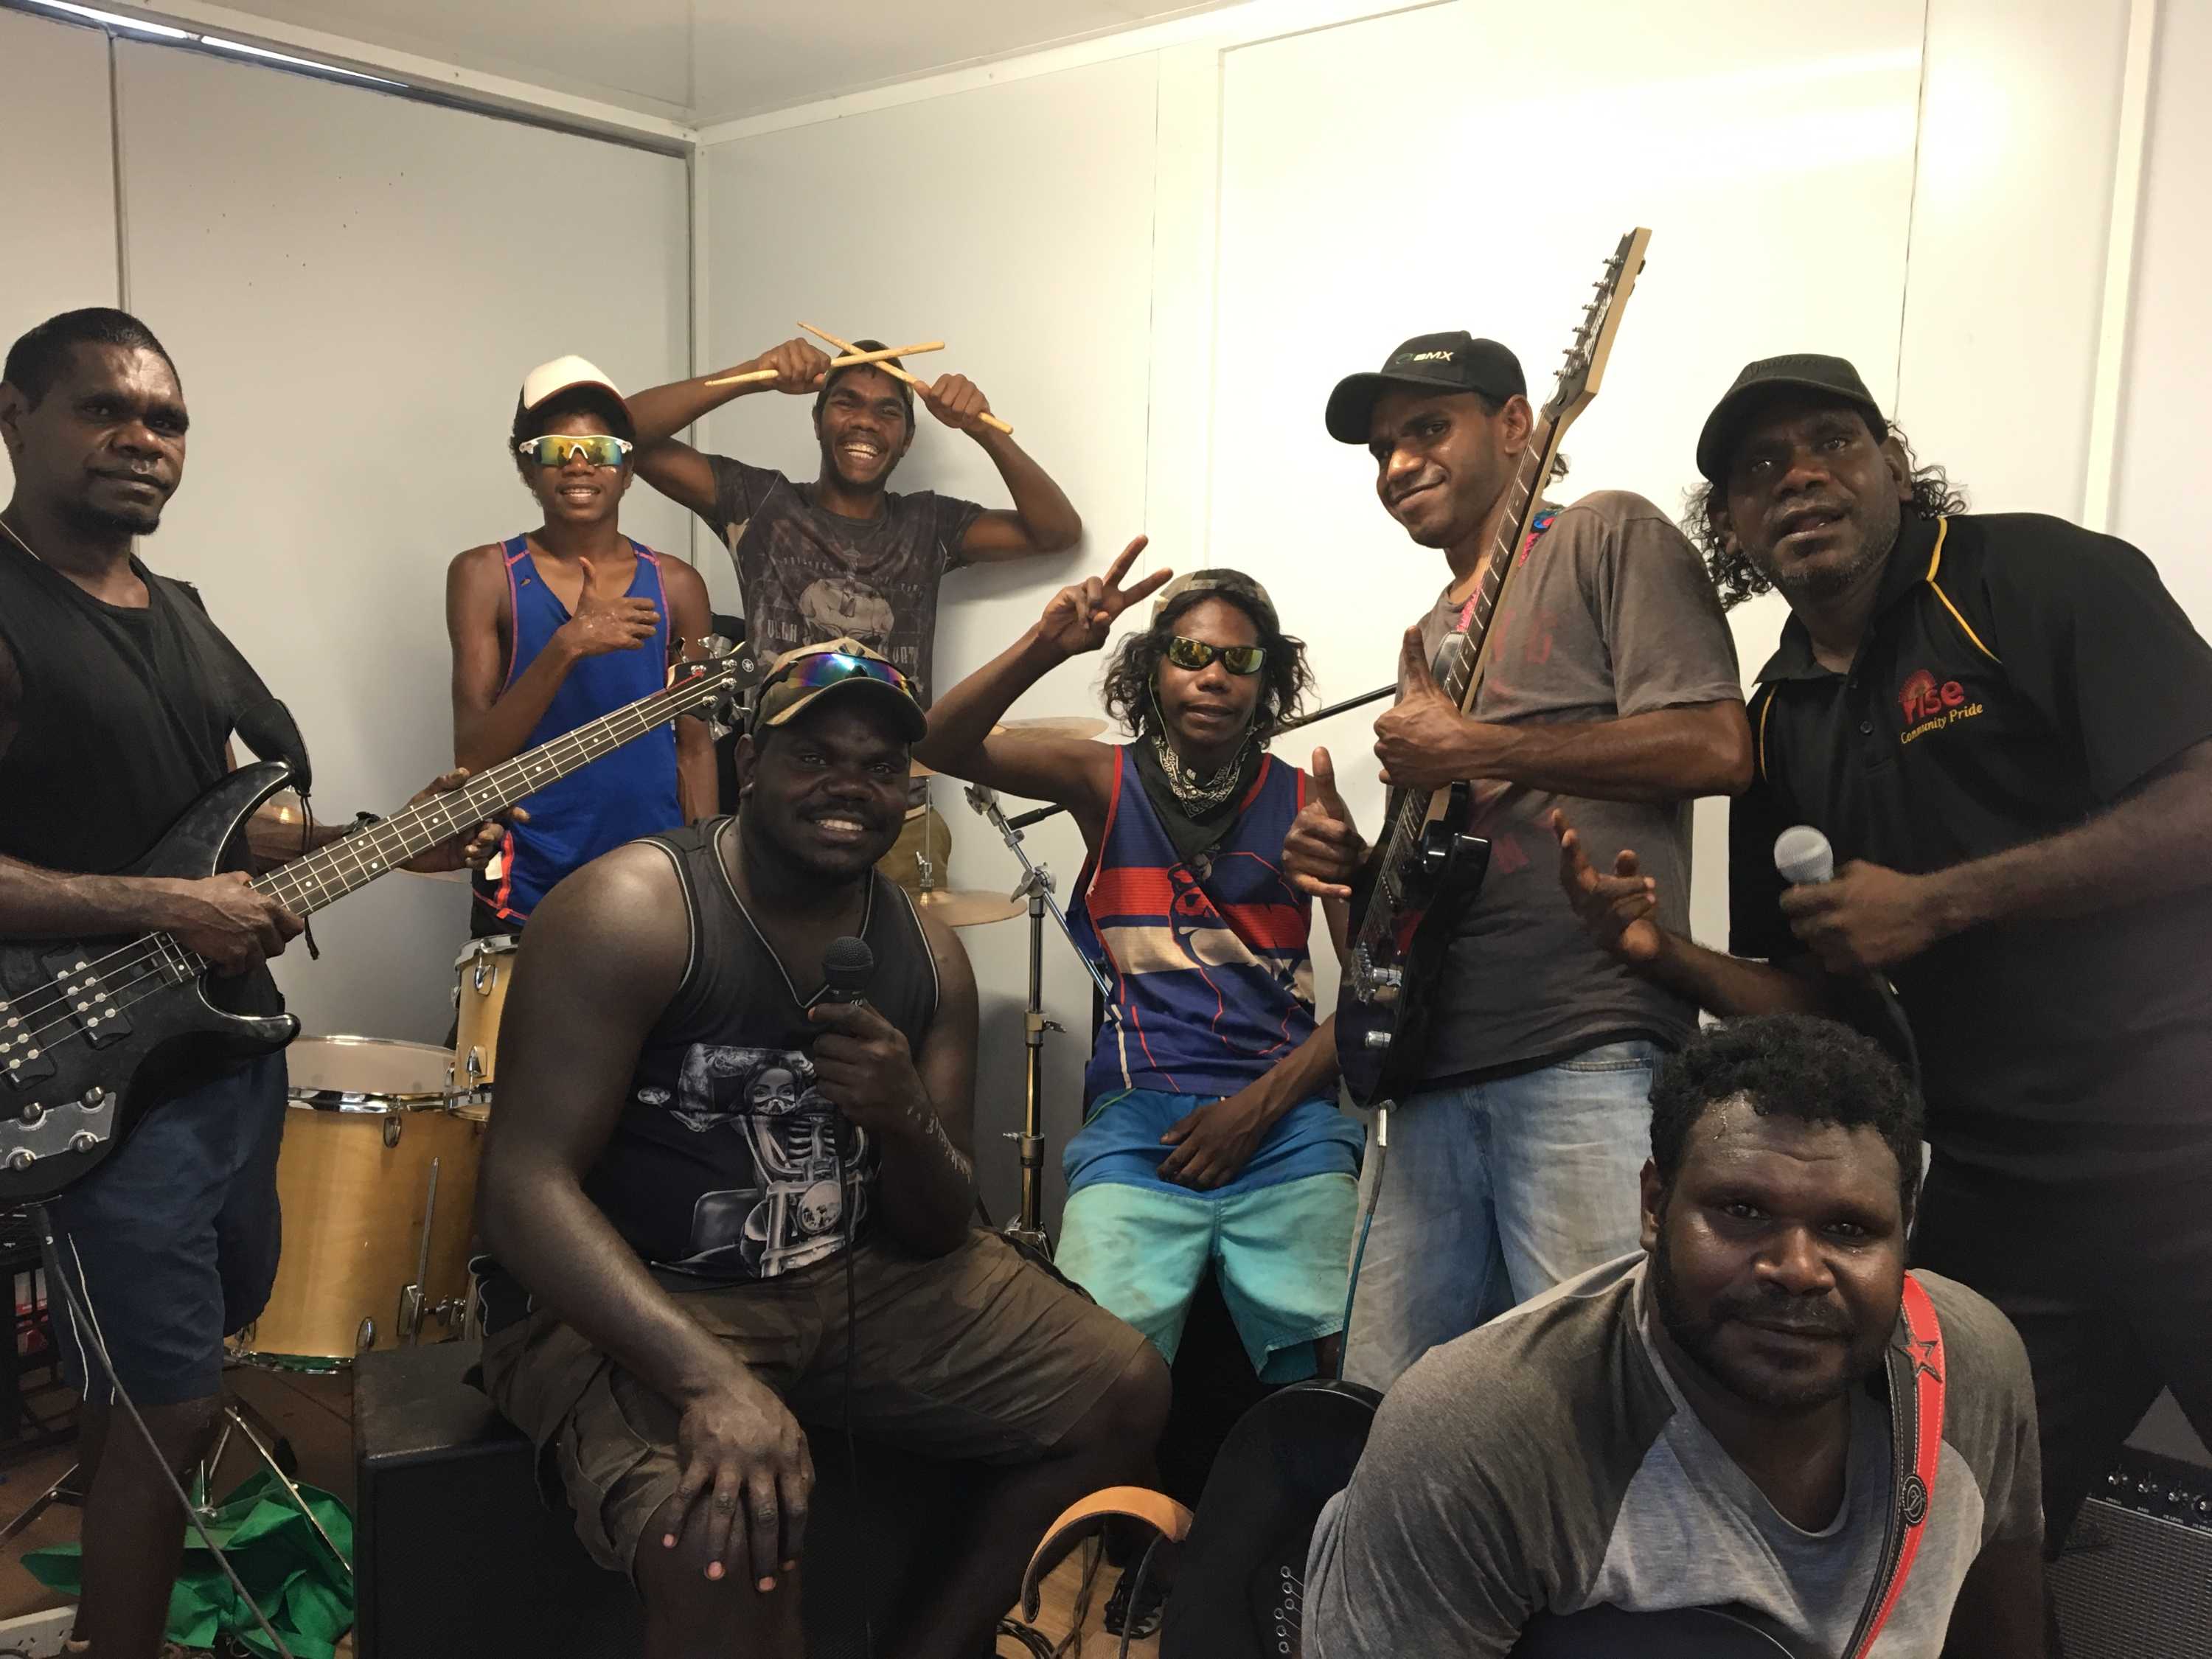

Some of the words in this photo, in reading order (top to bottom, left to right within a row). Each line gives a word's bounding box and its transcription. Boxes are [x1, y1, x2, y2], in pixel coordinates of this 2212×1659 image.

[1413, 350, 1455, 362] BMX
[1900, 716, 1947, 744] Community
[1949, 703, 1983, 723] Pride
